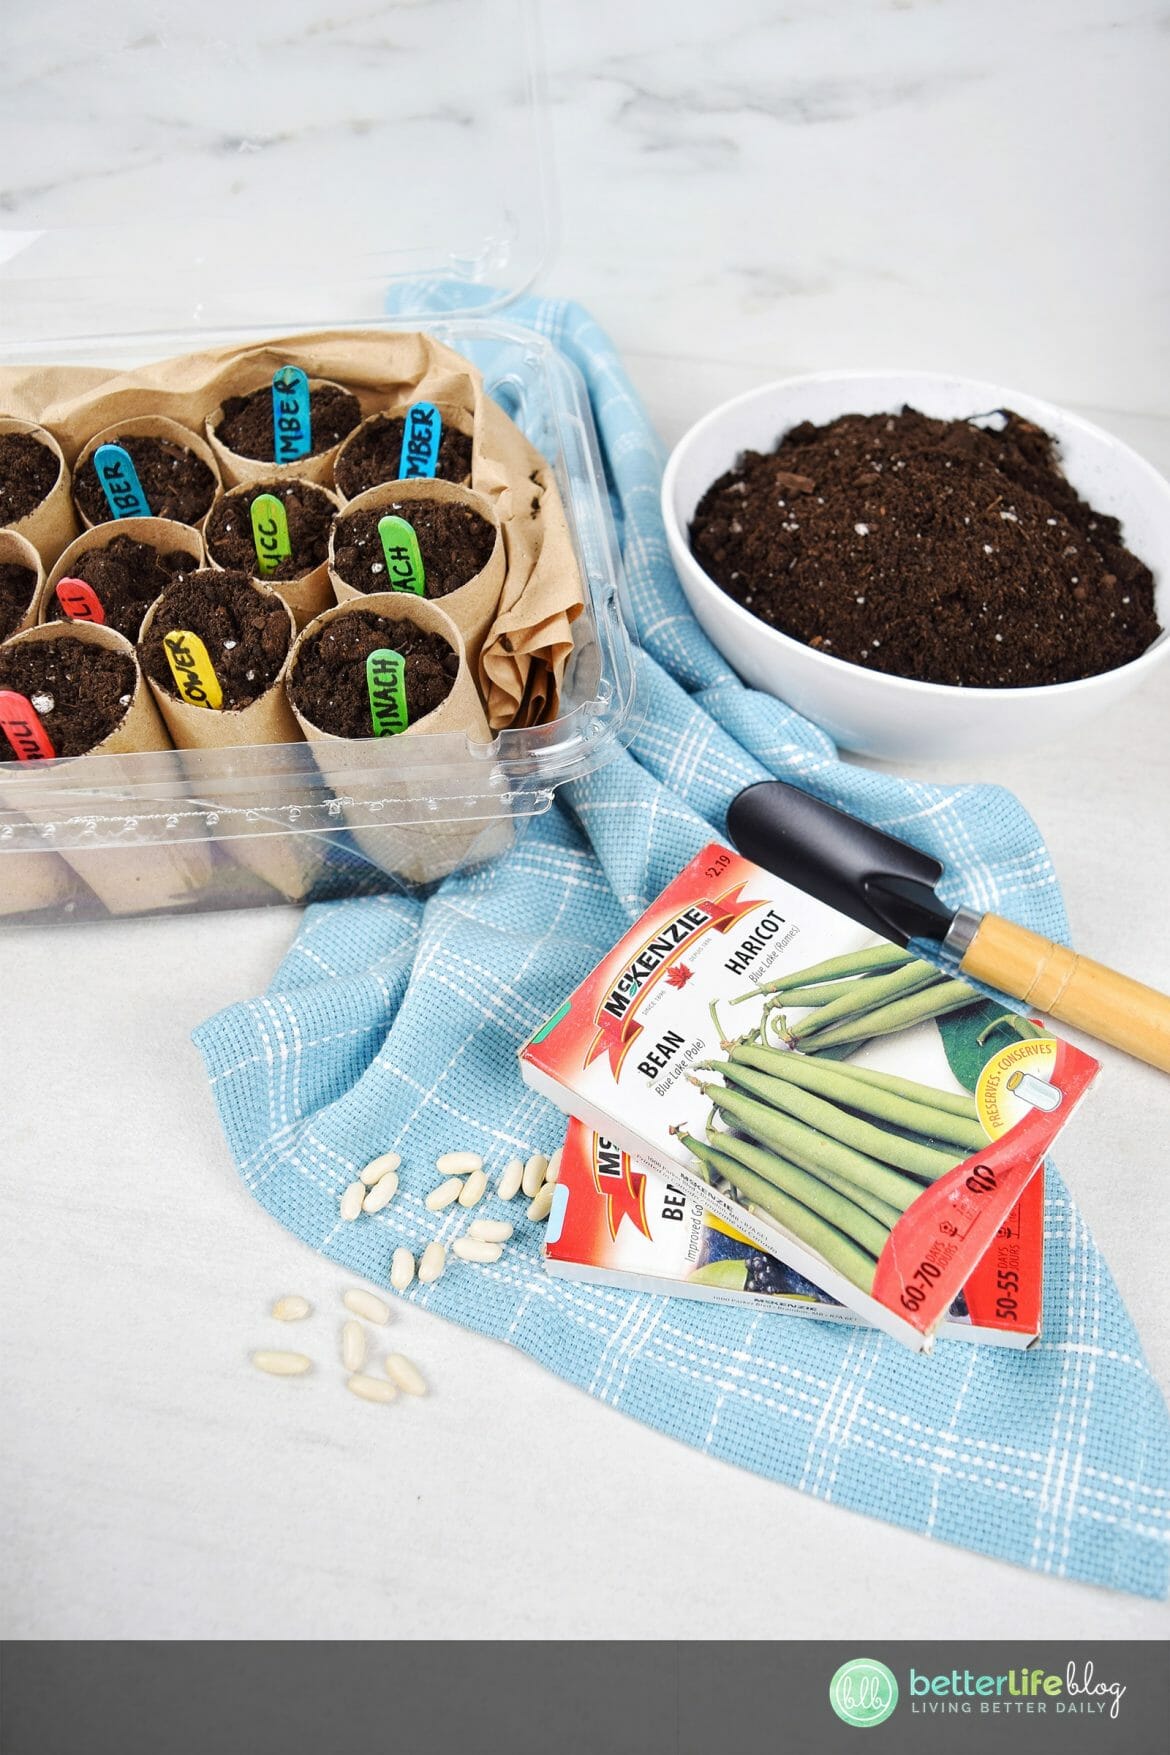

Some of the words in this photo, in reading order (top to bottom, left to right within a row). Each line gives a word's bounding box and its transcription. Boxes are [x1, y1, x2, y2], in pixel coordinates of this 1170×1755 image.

[103, 462, 141, 517] BER
[705, 855, 730, 879] $2.19
[724, 909, 786, 976] HARICOT
[747, 964, 766, 983] Blue
[760, 949, 779, 968] Lake
[773, 923, 800, 953] (Rames)
[637, 1030, 686, 1079] BEAN
[654, 1075, 674, 1096] Blue
[668, 1058, 688, 1080] Lake
[682, 1036, 706, 1063] (Pole)
[985, 1075, 1004, 1128] PRESERVES
[998, 1044, 1052, 1070] CONSERVES
[690, 1200, 704, 1216] Go
[684, 1217, 703, 1262] Improved
[935, 1242, 958, 1270] JOURS
[996, 1246, 1009, 1269] DAYS
[1007, 1244, 1021, 1270] JOURS
[901, 1261, 941, 1312] 60-70
[924, 1238, 945, 1262] DAYS
[996, 1270, 1018, 1321] 50-55
